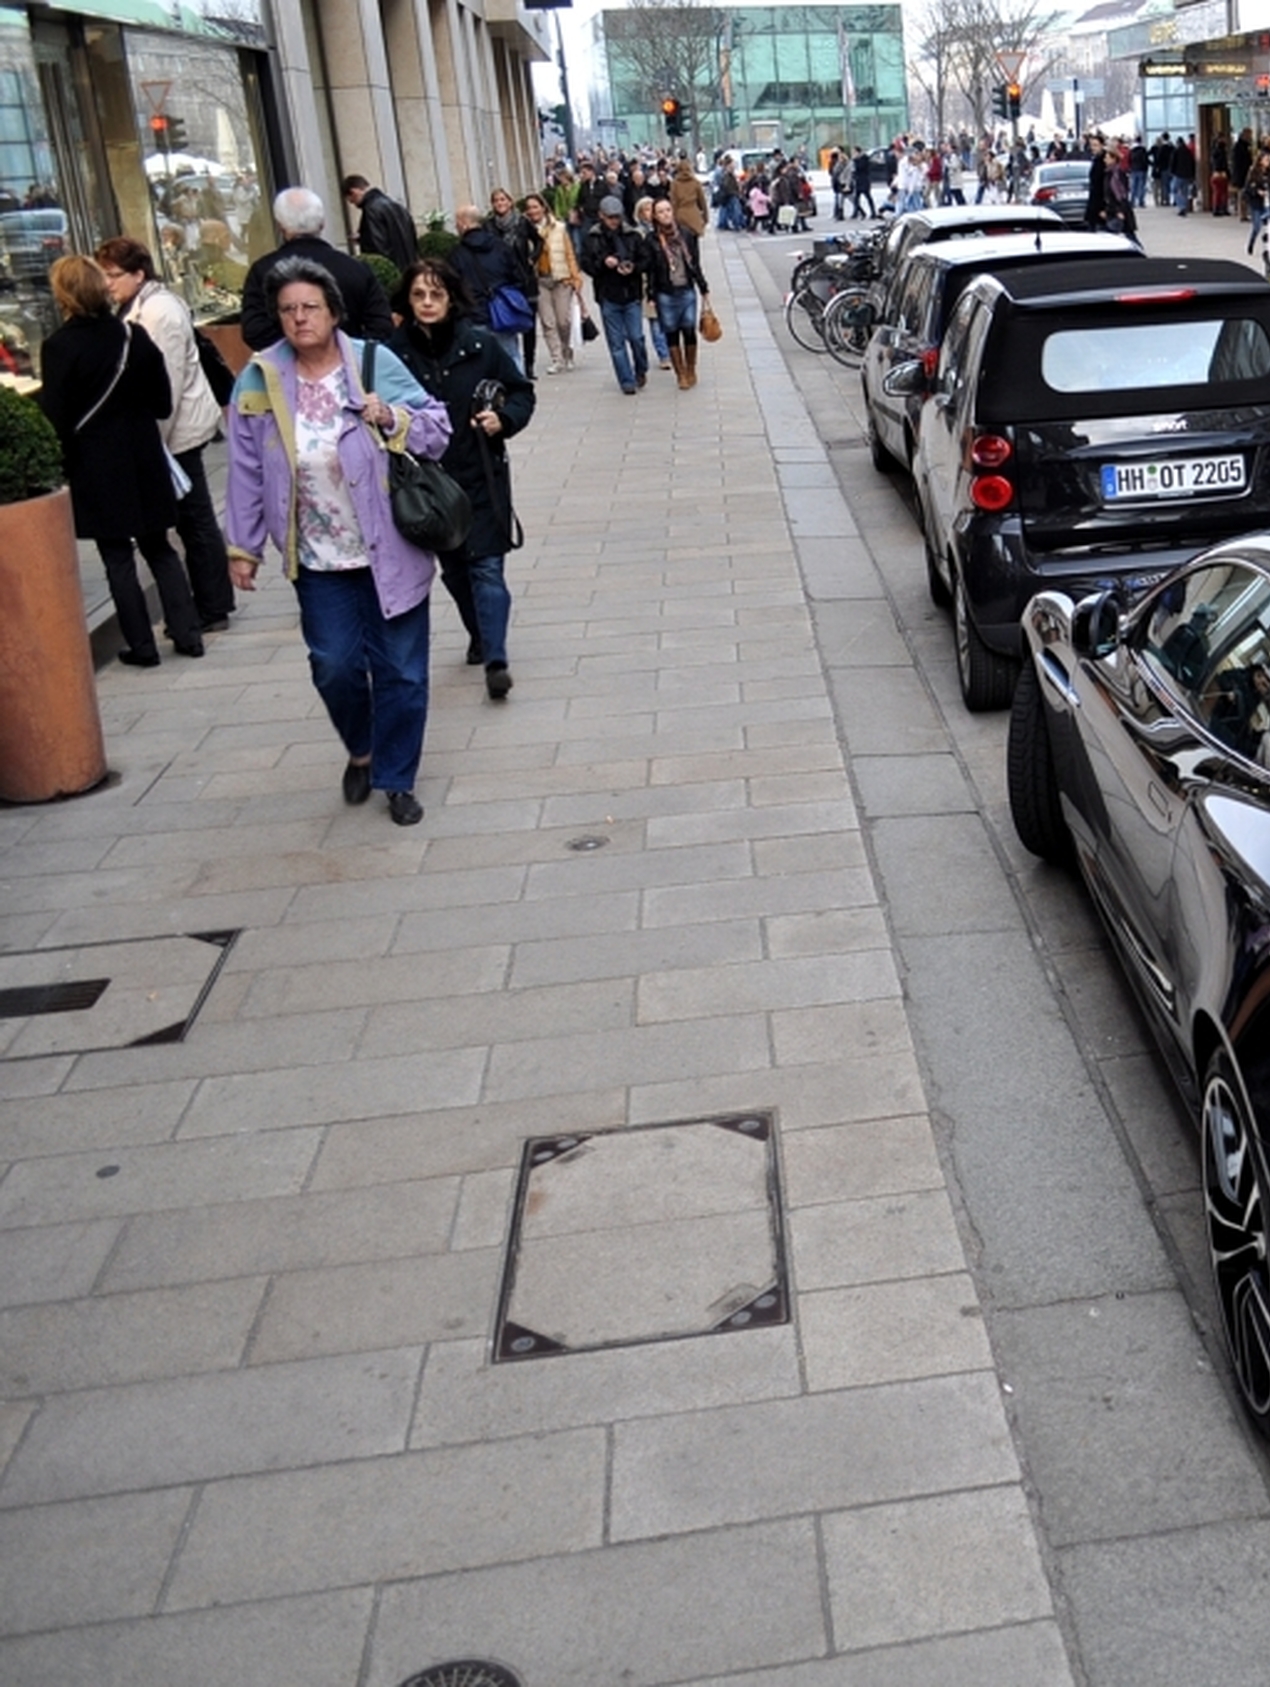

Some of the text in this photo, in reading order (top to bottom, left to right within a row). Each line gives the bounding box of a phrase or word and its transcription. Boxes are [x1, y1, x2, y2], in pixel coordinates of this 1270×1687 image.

[1117, 468, 1145, 492] HH
[1159, 465, 1186, 489] OT
[1191, 459, 1243, 486] 2205
